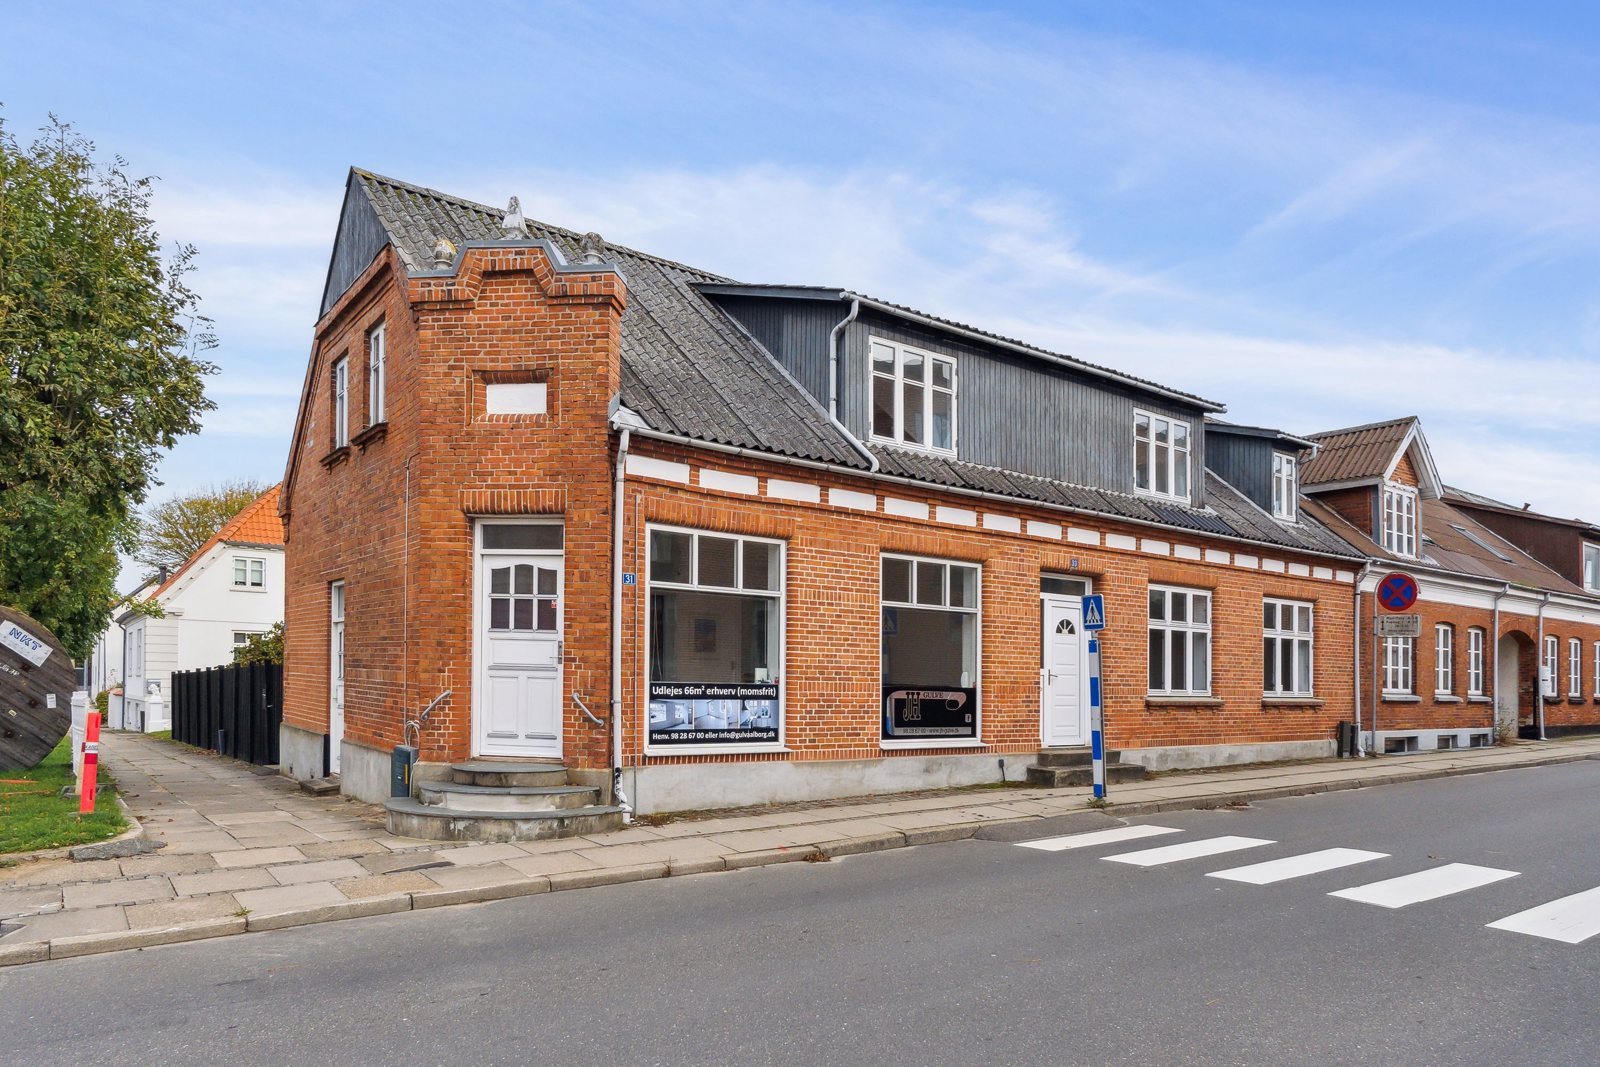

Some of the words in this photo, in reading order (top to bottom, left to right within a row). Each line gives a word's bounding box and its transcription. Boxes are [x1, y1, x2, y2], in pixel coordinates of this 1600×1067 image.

[625, 574, 633, 584] 31
[9, 627, 42, 651] NKT
[652, 686, 682, 696] Udlejes
[684, 685, 705, 695] 66m²
[706, 686, 735, 695] erhverv
[737, 687, 776, 697] (momsfrit)
[902, 691, 922, 722] JH
